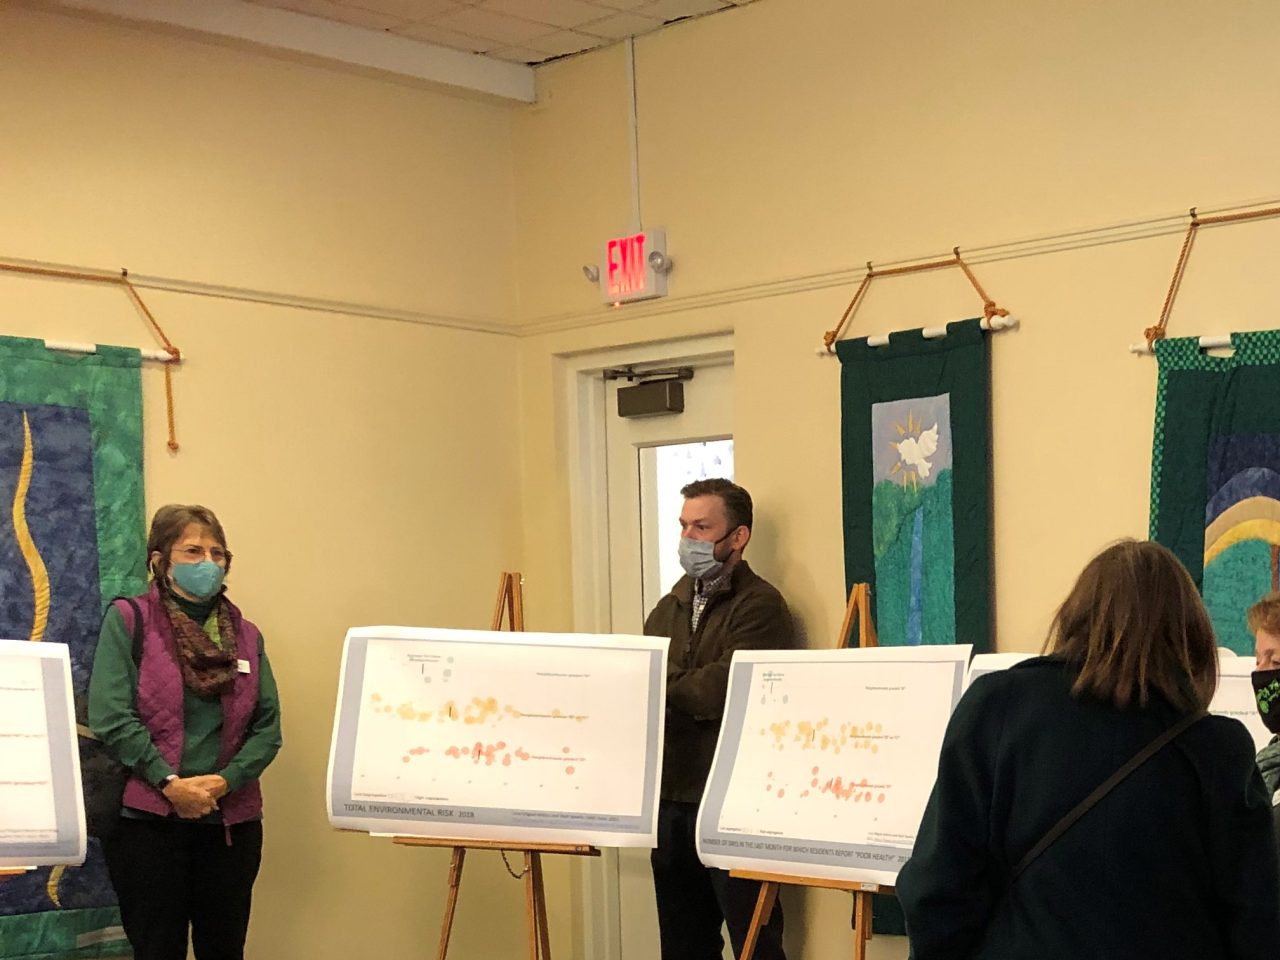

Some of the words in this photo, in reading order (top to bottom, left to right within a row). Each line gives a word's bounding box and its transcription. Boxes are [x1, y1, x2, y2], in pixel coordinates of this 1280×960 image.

[607, 234, 645, 295] EXIT
[344, 804, 366, 812] TOTAL
[369, 805, 434, 816] ENVIRONMENTAL
[438, 808, 454, 816] RISK
[810, 847, 834, 856] RESIDENTS
[856, 851, 871, 859] "POOR
[872, 853, 896, 861] HEALTH"
